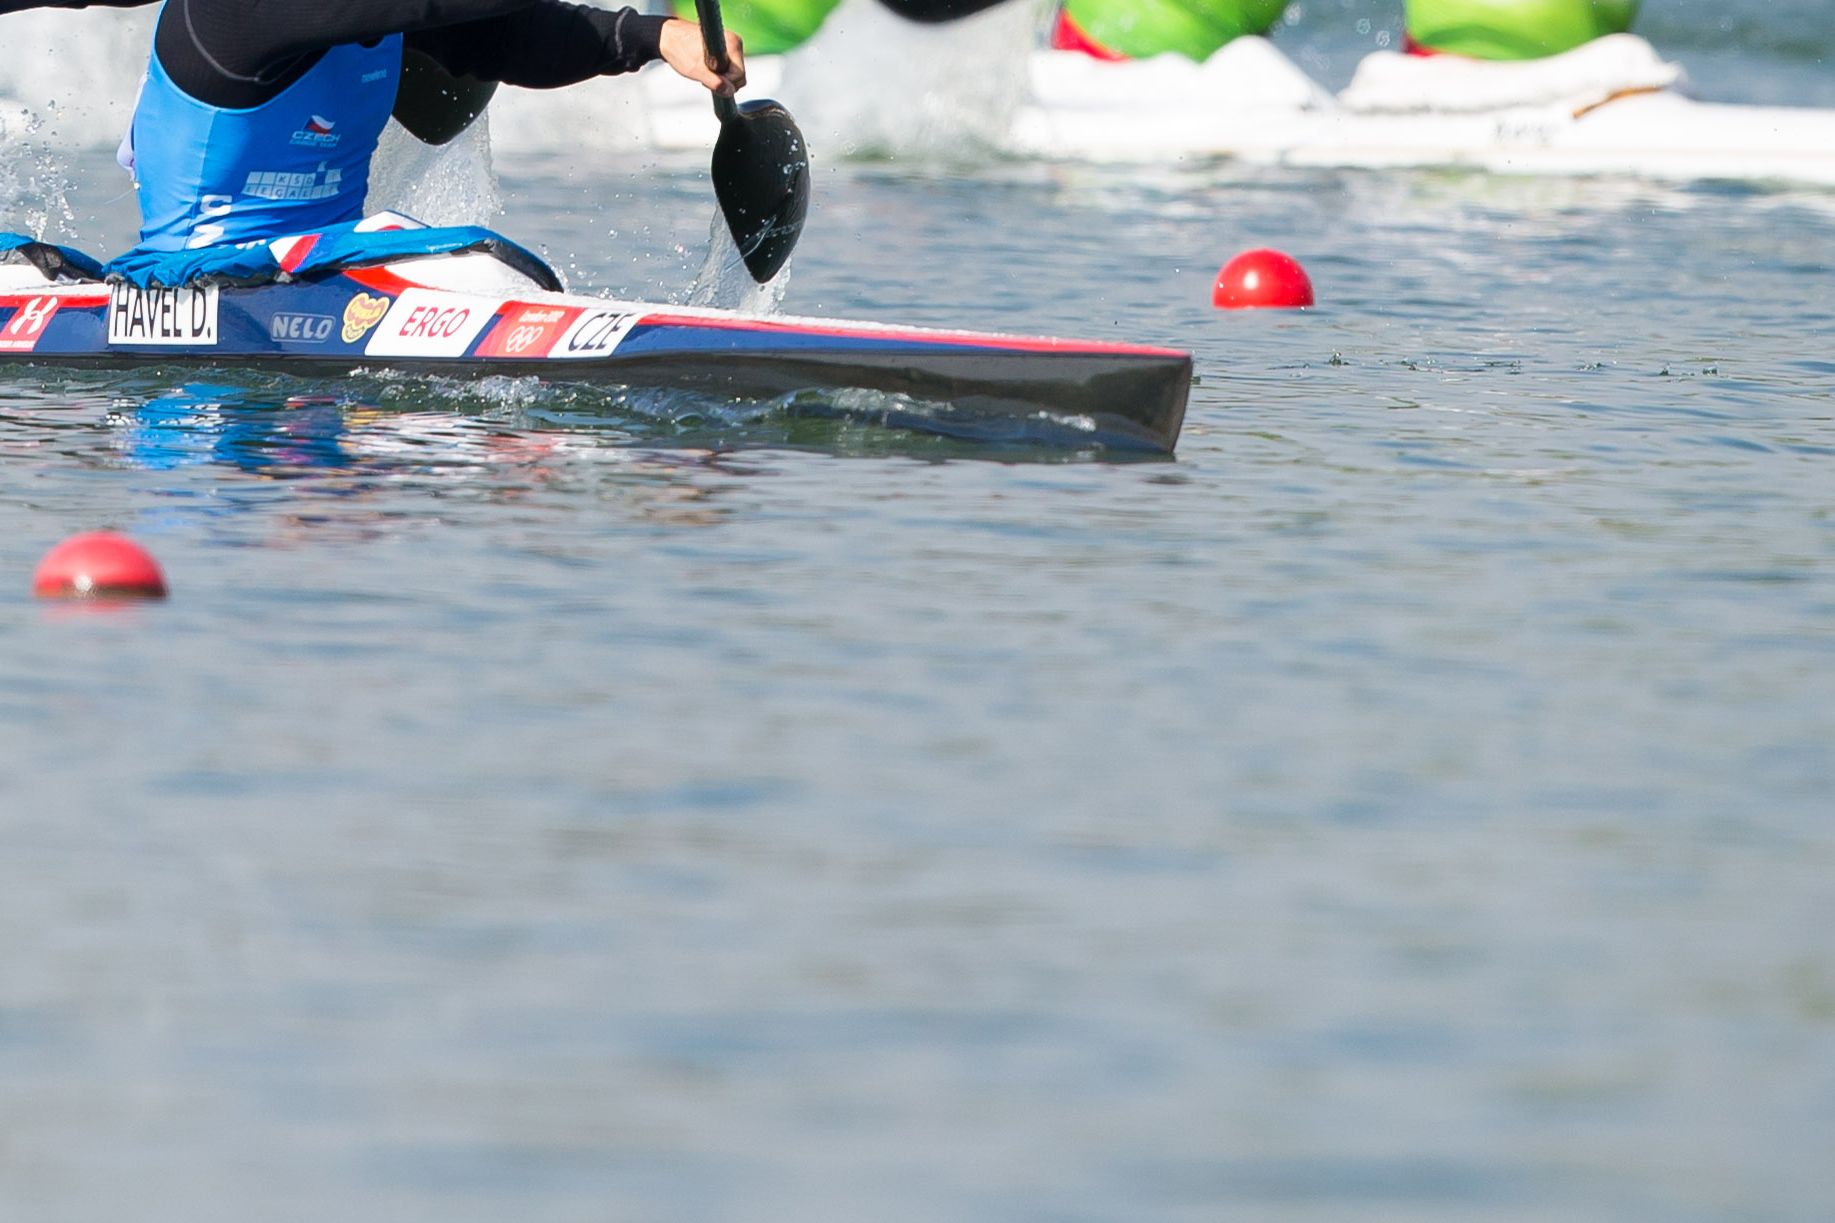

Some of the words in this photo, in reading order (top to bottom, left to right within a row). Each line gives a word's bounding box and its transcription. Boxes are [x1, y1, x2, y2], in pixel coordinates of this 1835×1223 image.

[292, 130, 341, 143] CZECH
[114, 285, 183, 338] HAVEL
[190, 288, 212, 339] D.
[398, 306, 471, 338] ERGO
[568, 311, 636, 352] CZE
